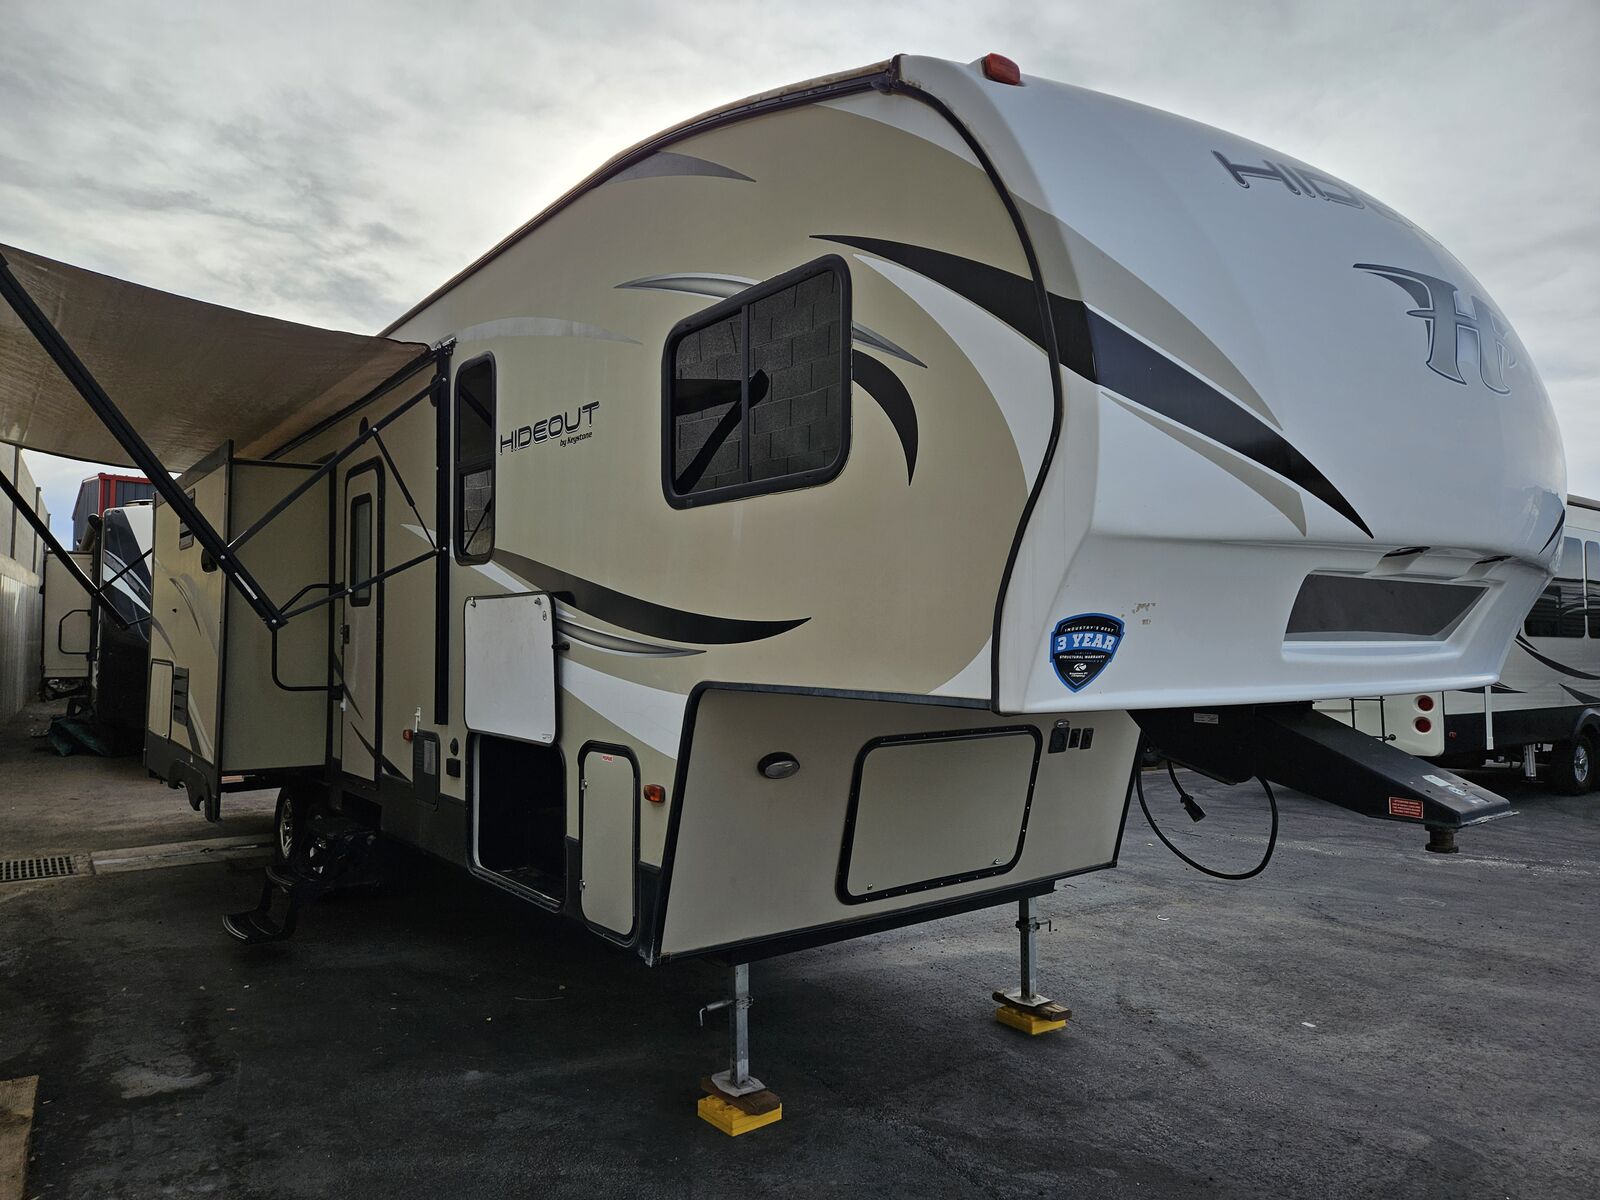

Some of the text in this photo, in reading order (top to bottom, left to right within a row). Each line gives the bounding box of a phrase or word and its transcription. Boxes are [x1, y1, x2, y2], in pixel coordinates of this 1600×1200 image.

[499, 400, 600, 455] HIDEOUT
[559, 439, 567, 447] by
[1057, 633, 1116, 651] 3 YEAR
